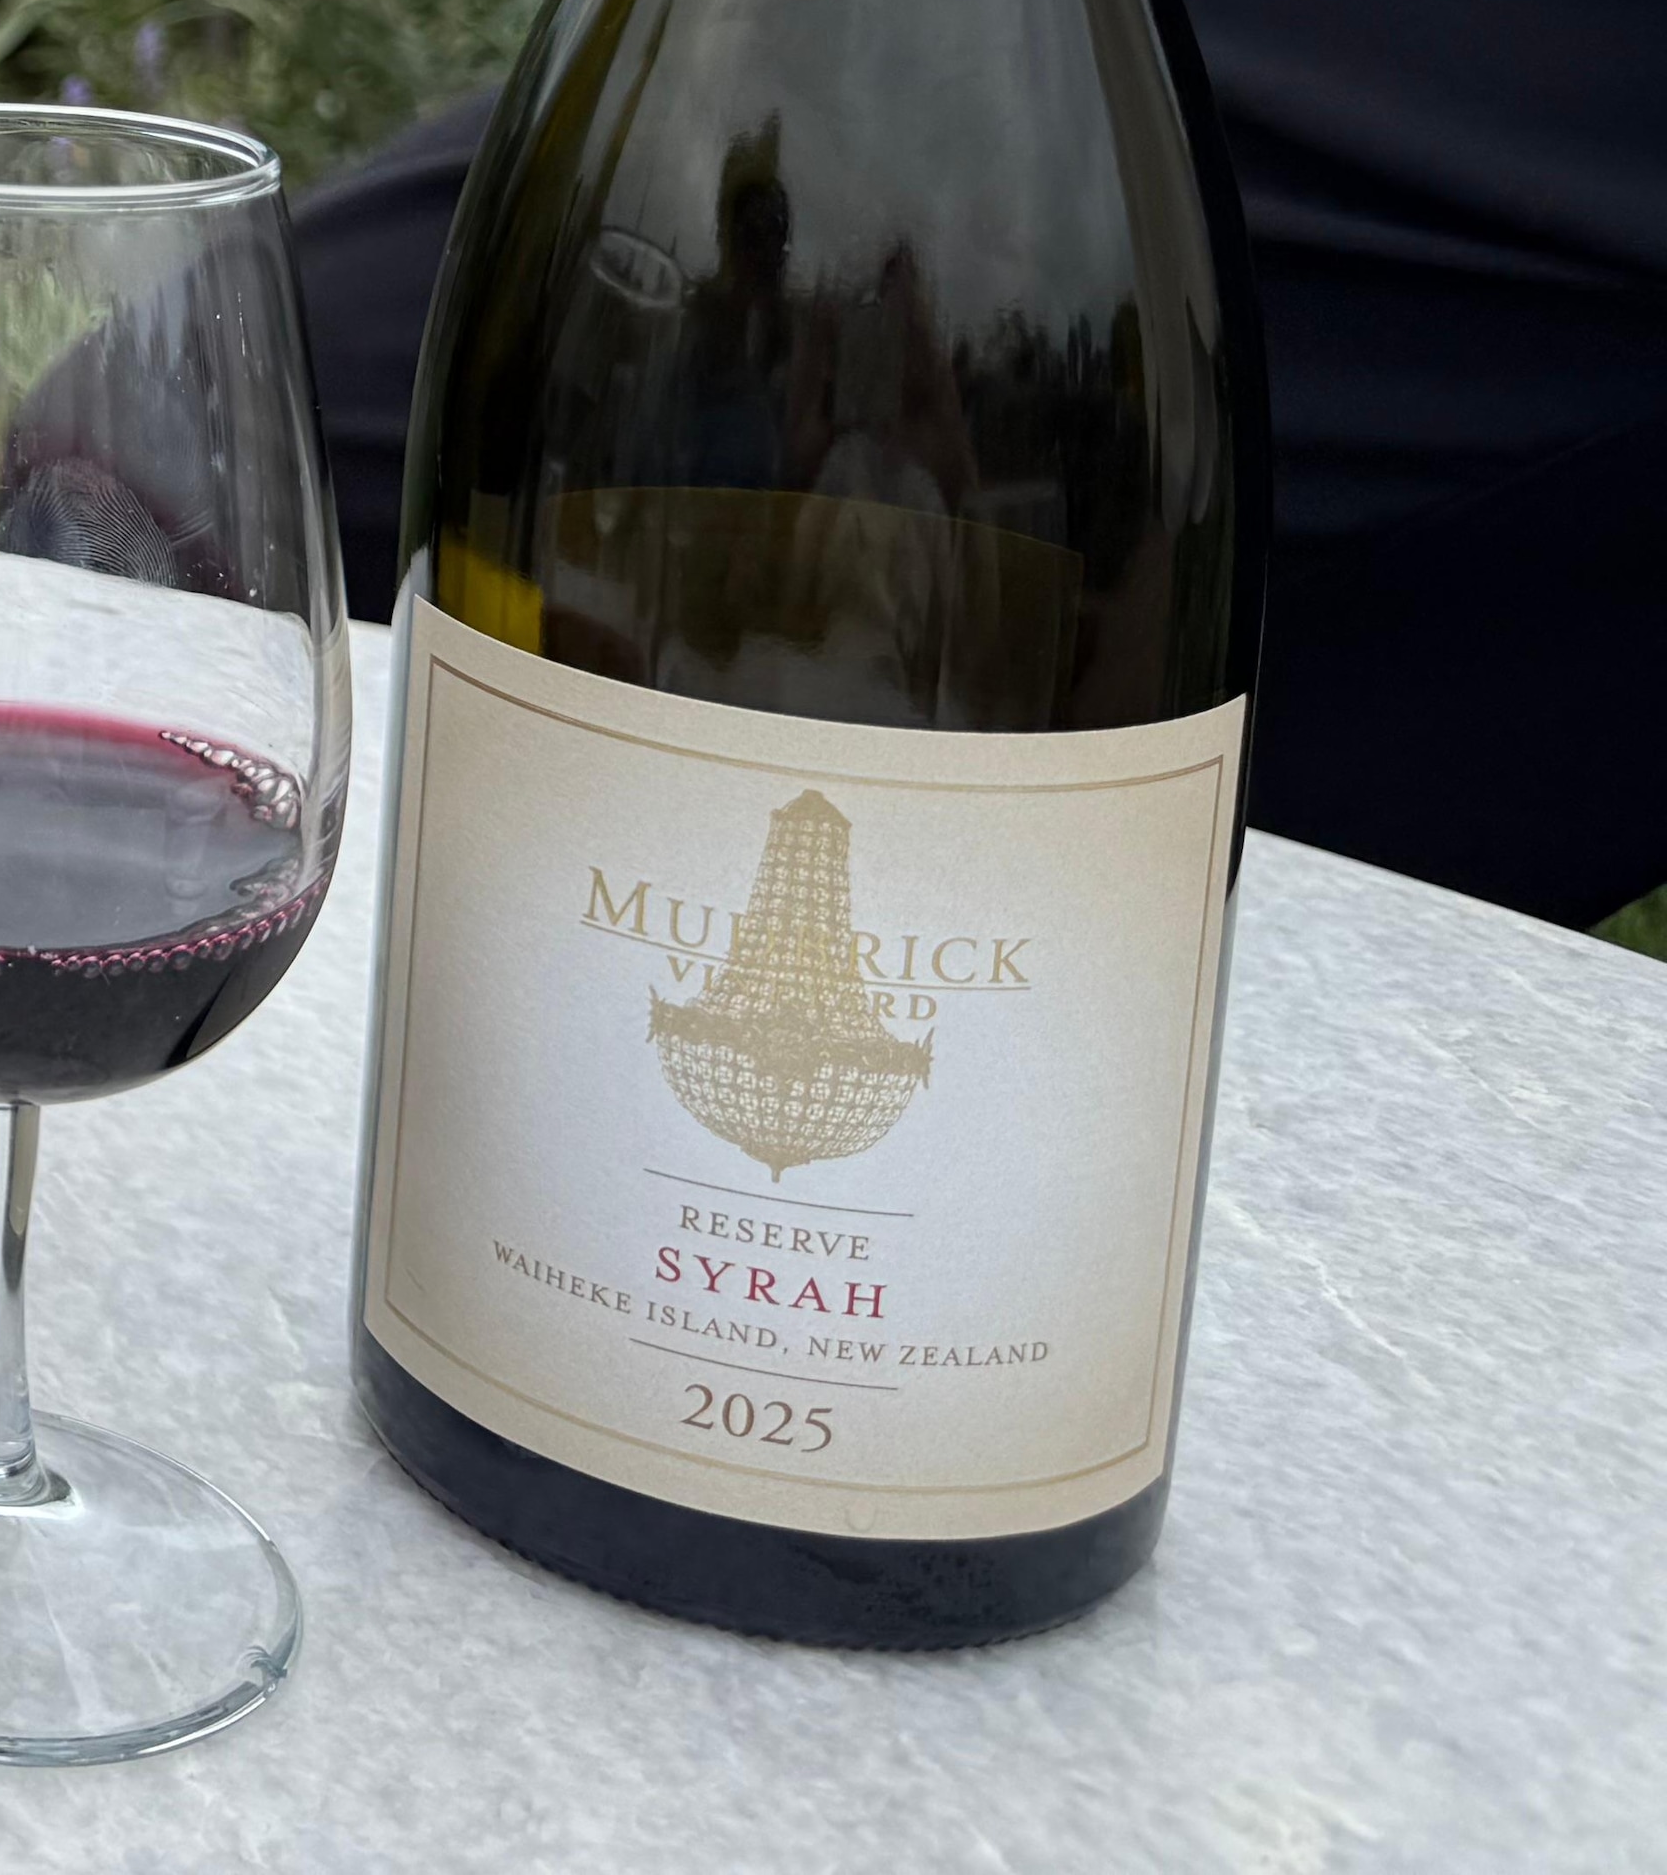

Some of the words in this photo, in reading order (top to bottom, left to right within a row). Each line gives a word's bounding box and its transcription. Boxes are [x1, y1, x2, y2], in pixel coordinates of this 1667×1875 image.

[679, 1204, 870, 1261] RESERVE
[491, 1240, 633, 1314] WAIHEKE
[646, 1301, 792, 1355] ISLAND,
[807, 1335, 886, 1364] NEW
[898, 1341, 1050, 1367] ZEALAND
[655, 1246, 888, 1318] SYRAH
[680, 1383, 834, 1453] 2025
